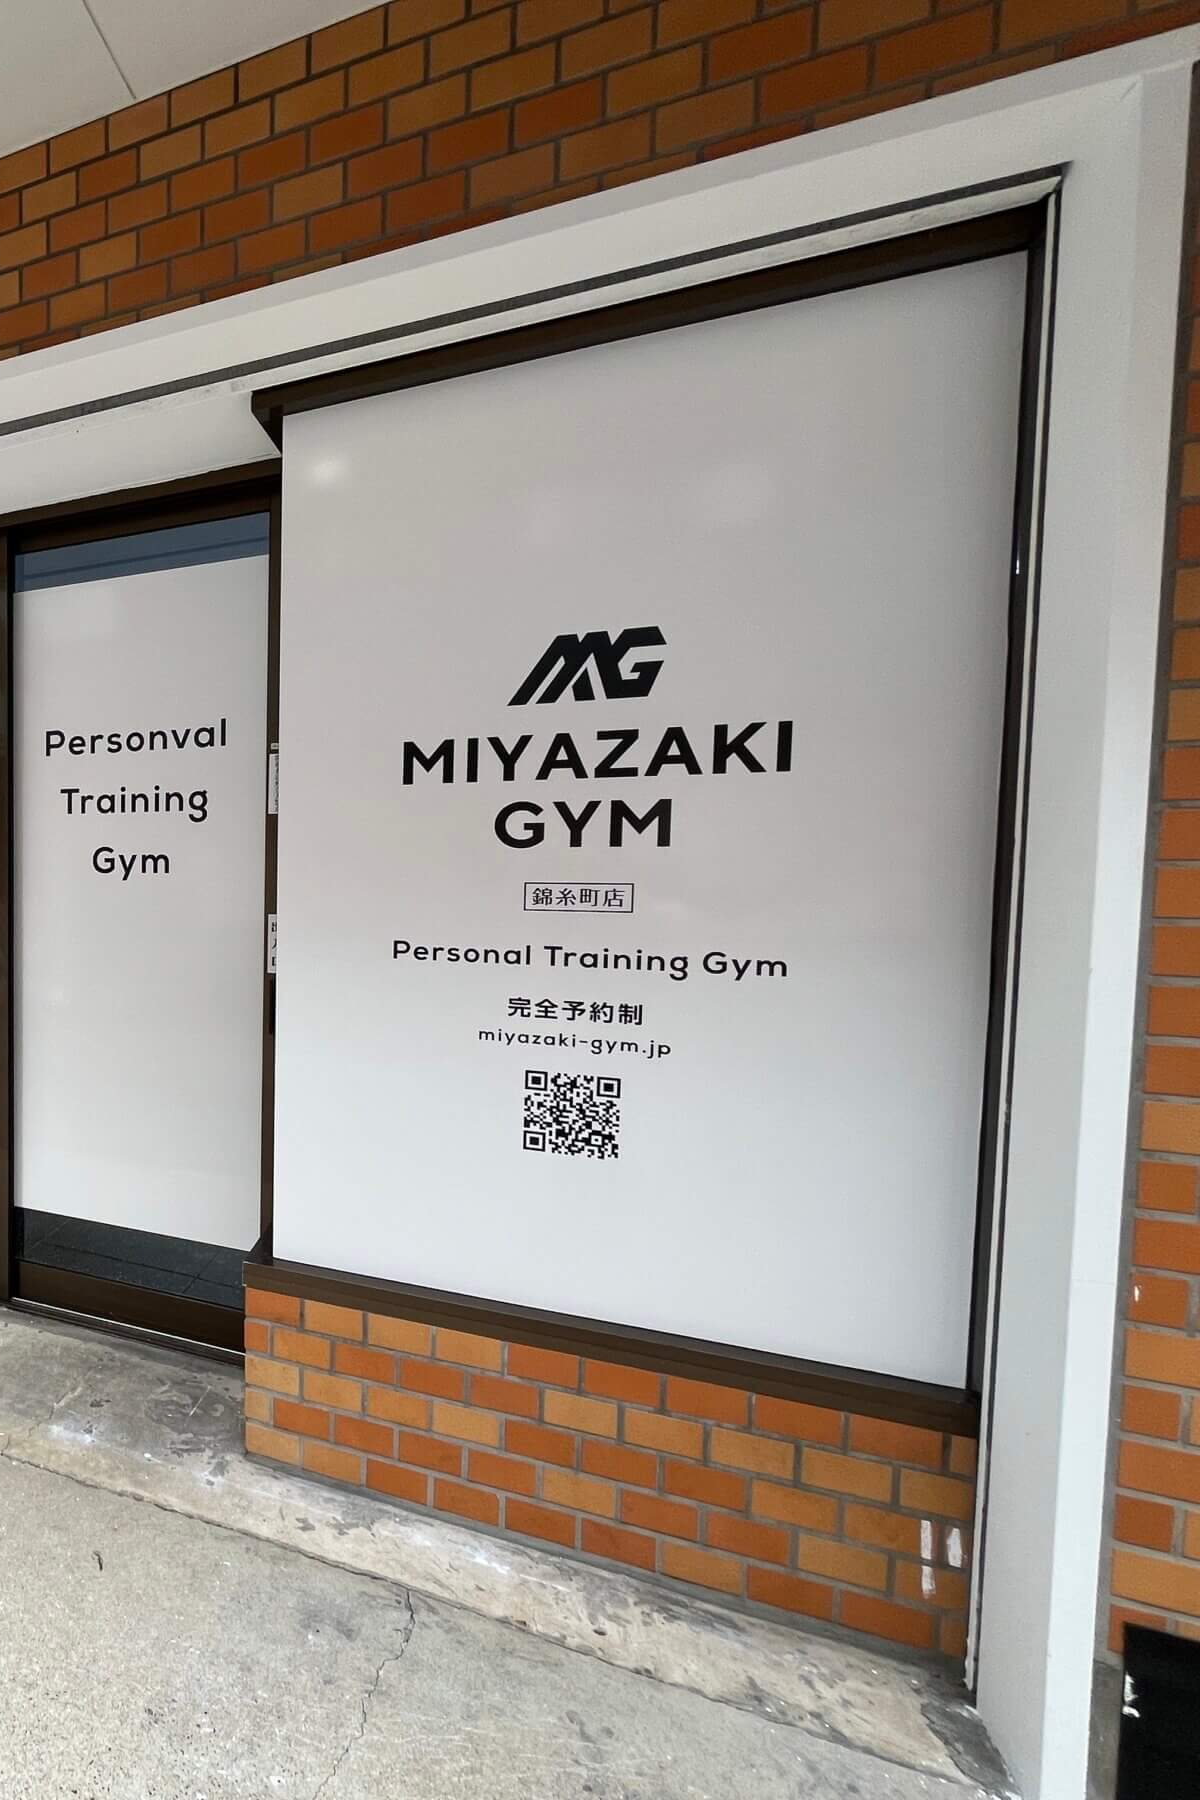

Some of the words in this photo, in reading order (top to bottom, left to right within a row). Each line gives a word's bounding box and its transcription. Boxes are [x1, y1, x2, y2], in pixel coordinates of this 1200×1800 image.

[46, 718, 227, 757] Personval
[402, 720, 794, 786] MIYAZAKI
[61, 785, 208, 822] Training
[494, 798, 673, 849] GYM
[92, 846, 170, 881] Gym
[532, 887, 625, 908] 錦糸町店
[393, 940, 531, 966] Personal
[543, 945, 689, 981] Training
[702, 951, 788, 981] Gym
[507, 997, 643, 1026] 完全予約制
[478, 1029, 671, 1059] miyazaki-gym.jp
